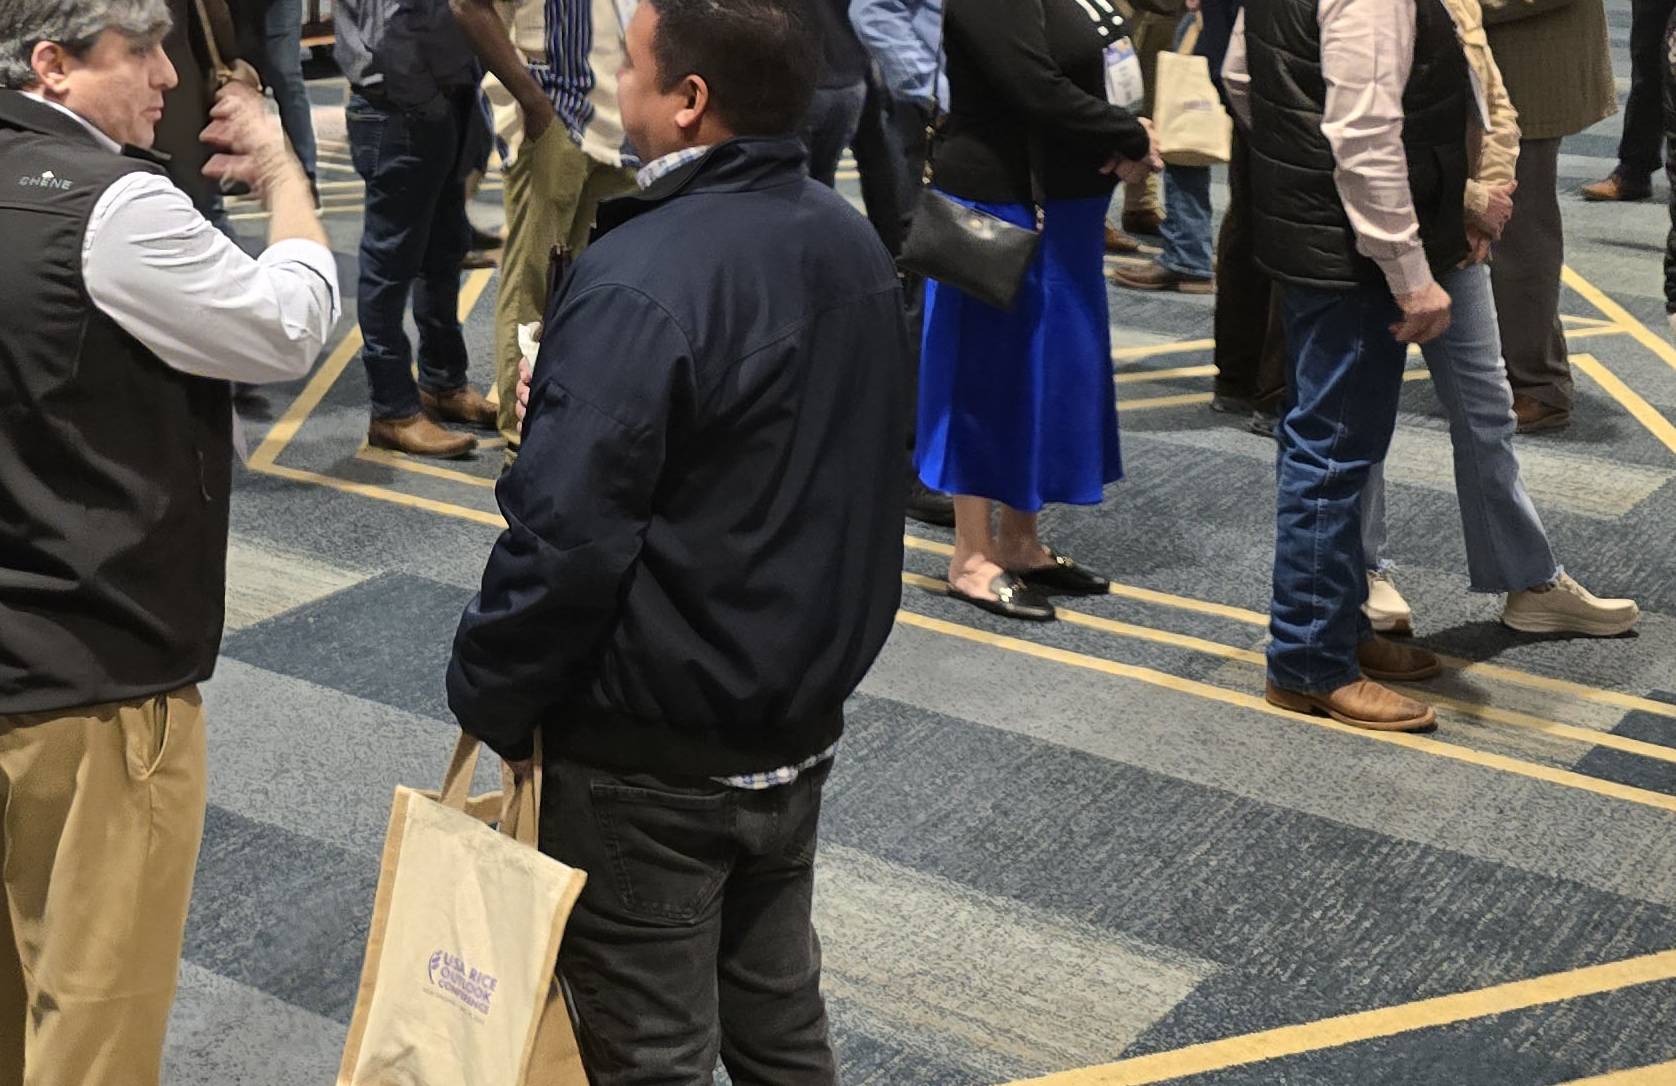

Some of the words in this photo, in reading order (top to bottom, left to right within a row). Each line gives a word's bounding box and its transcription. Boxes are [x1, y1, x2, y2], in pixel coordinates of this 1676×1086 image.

[18, 176, 74, 190] CHENE
[440, 966, 492, 1003] OUTLOOK
[443, 952, 466, 976] USA
[468, 968, 498, 992] RICE
